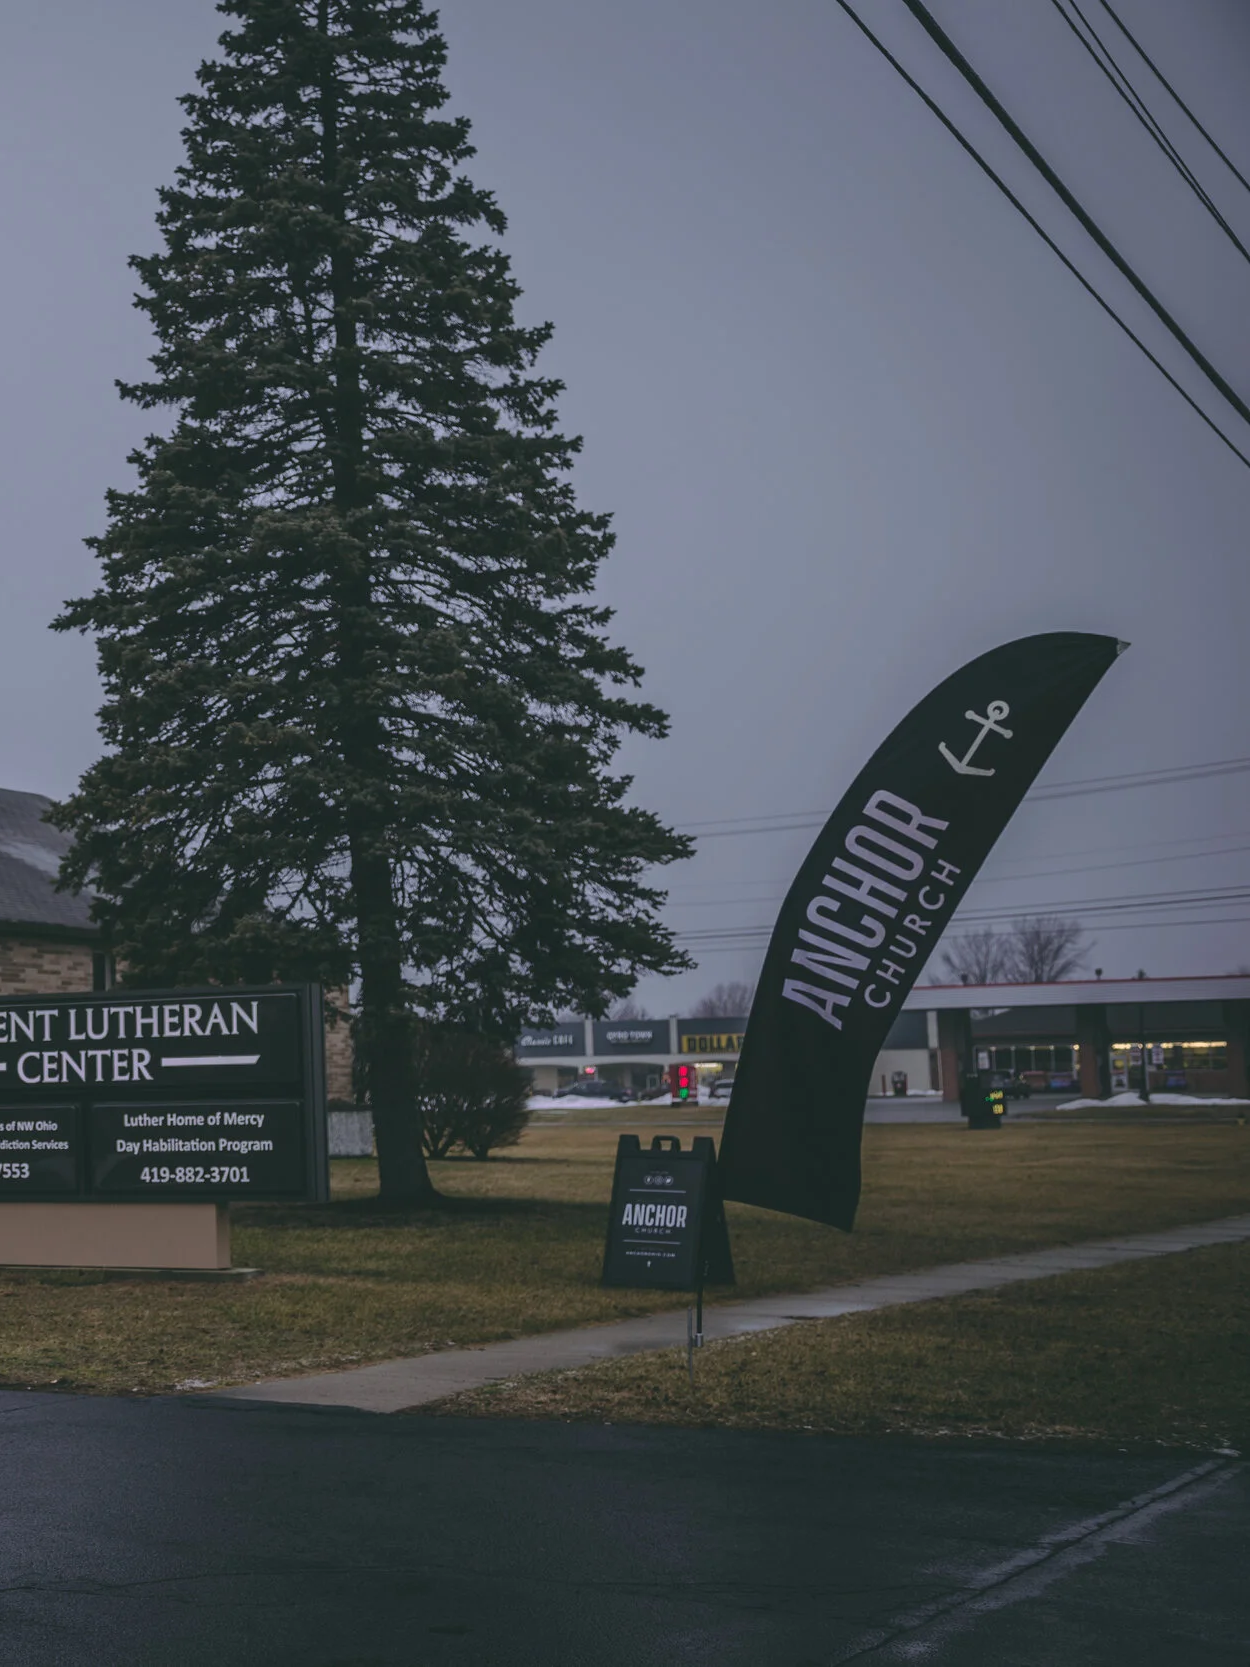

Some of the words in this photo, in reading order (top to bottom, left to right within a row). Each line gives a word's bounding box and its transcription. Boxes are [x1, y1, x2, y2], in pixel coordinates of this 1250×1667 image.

[781, 789, 950, 1031] ANCHOR
[863, 858, 962, 1008] CHURCH
[68, 1001, 259, 1041] LUTHERAN
[17, 1048, 154, 1084] CENTER
[6, 1120, 16, 1132] of
[16, 1120, 35, 1132] NW
[36, 1120, 58, 1132] Ohio
[123, 1113, 165, 1127] Luther
[166, 1113, 205, 1127] Home
[206, 1111, 222, 1126] of
[223, 1111, 265, 1128] Mercy
[31, 1139, 69, 1150] Services
[116, 1139, 141, 1155] Day
[142, 1137, 216, 1153] Habilitation
[218, 1137, 274, 1154] Program
[140, 1166, 250, 1183] 419-882-3701
[622, 1203, 688, 1228] ANCHOR
